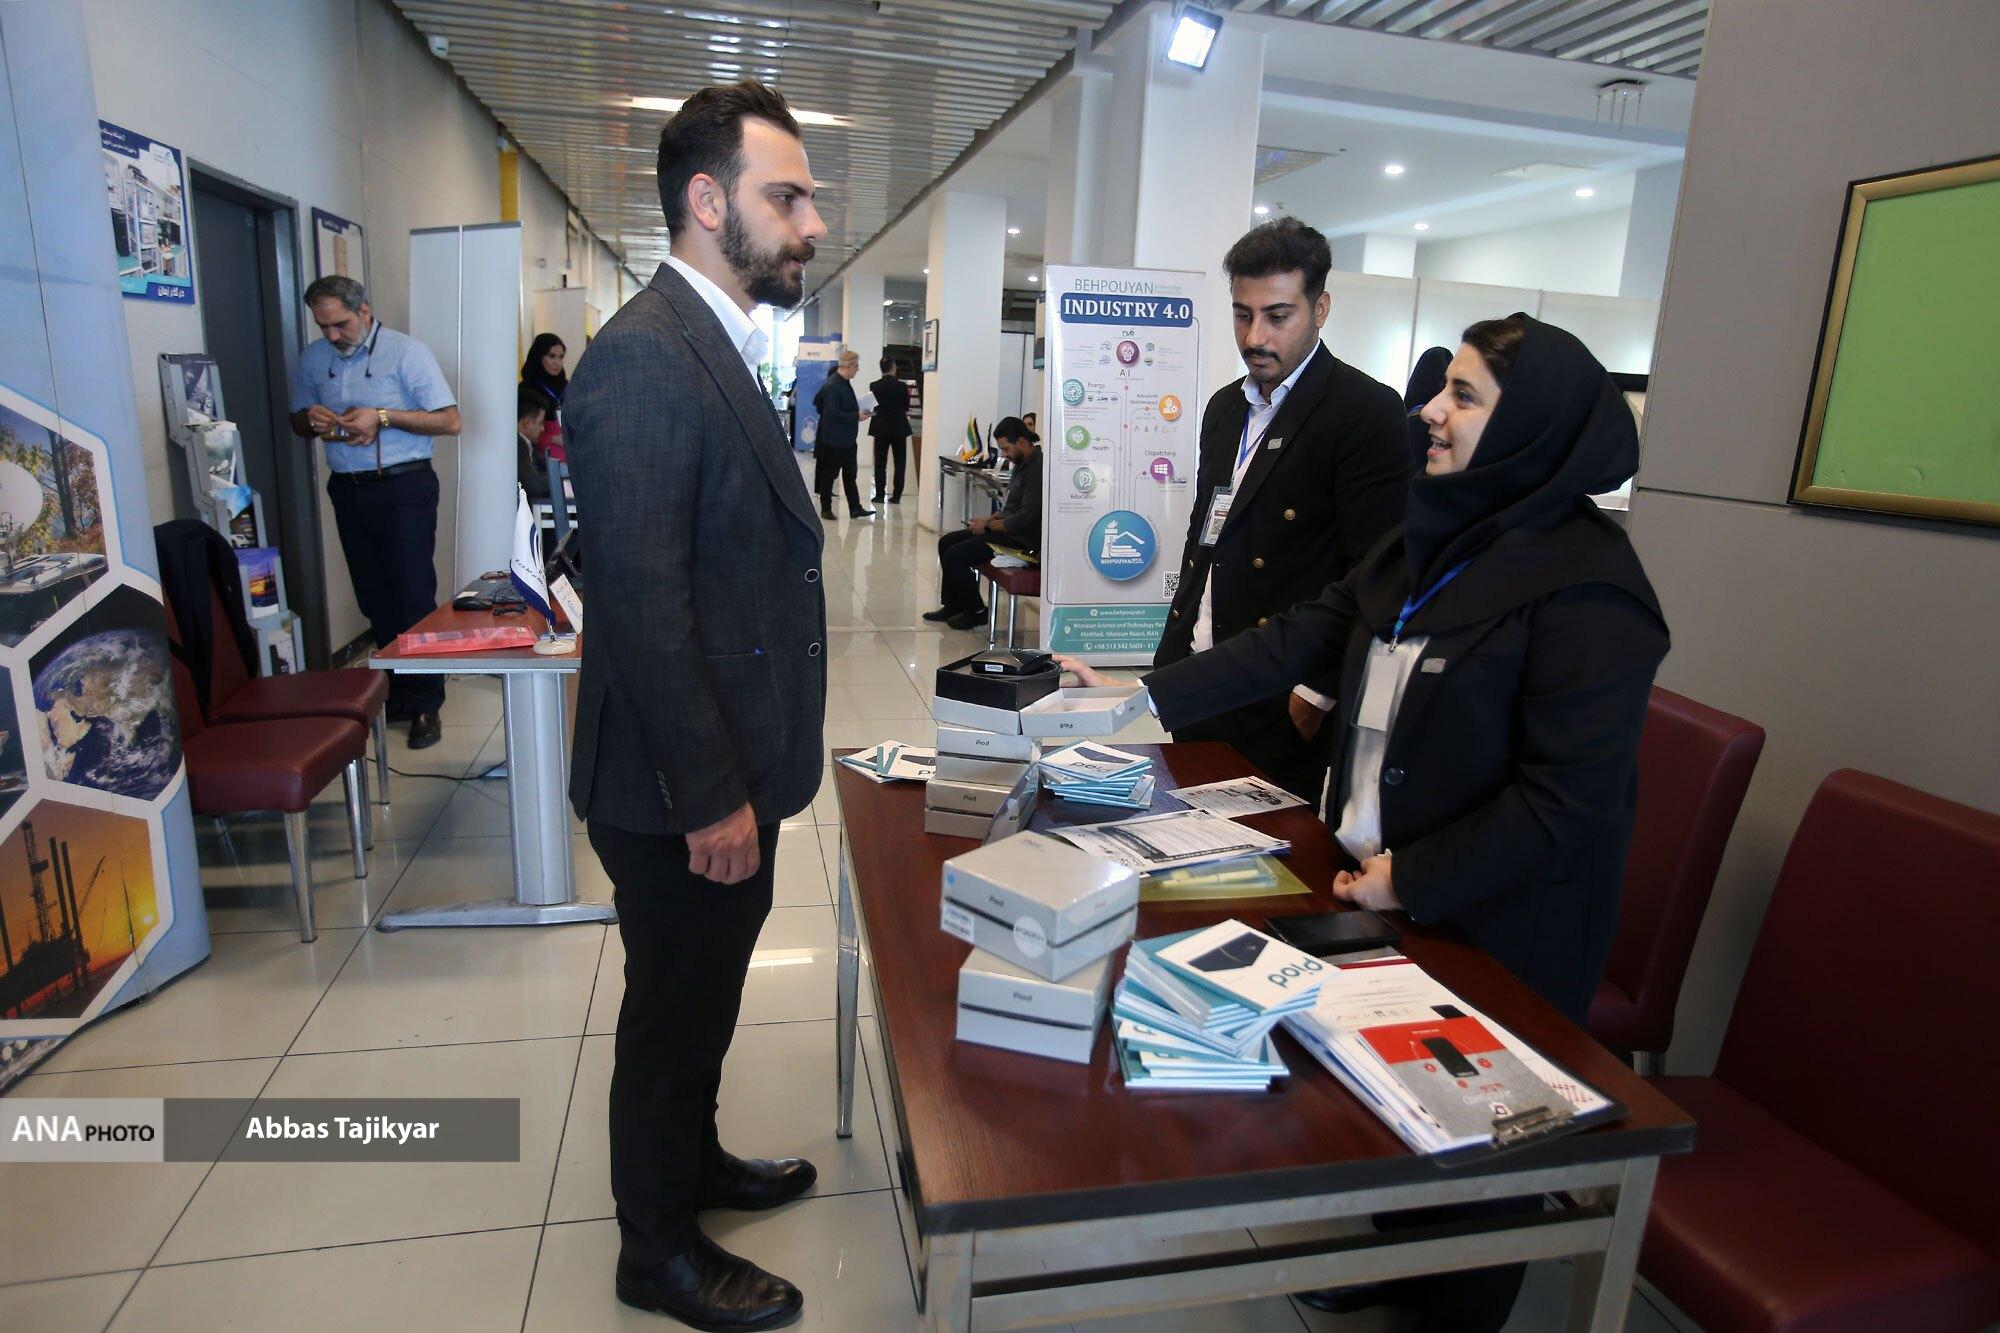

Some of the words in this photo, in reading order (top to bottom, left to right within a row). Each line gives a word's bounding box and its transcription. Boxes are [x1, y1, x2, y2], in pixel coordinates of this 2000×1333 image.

[1075, 279, 1154, 294] BEHPOUYAN
[1064, 299, 1158, 318] INDUSTRY
[1162, 303, 1190, 319] 4.0
[1088, 382, 1105, 390] Energy
